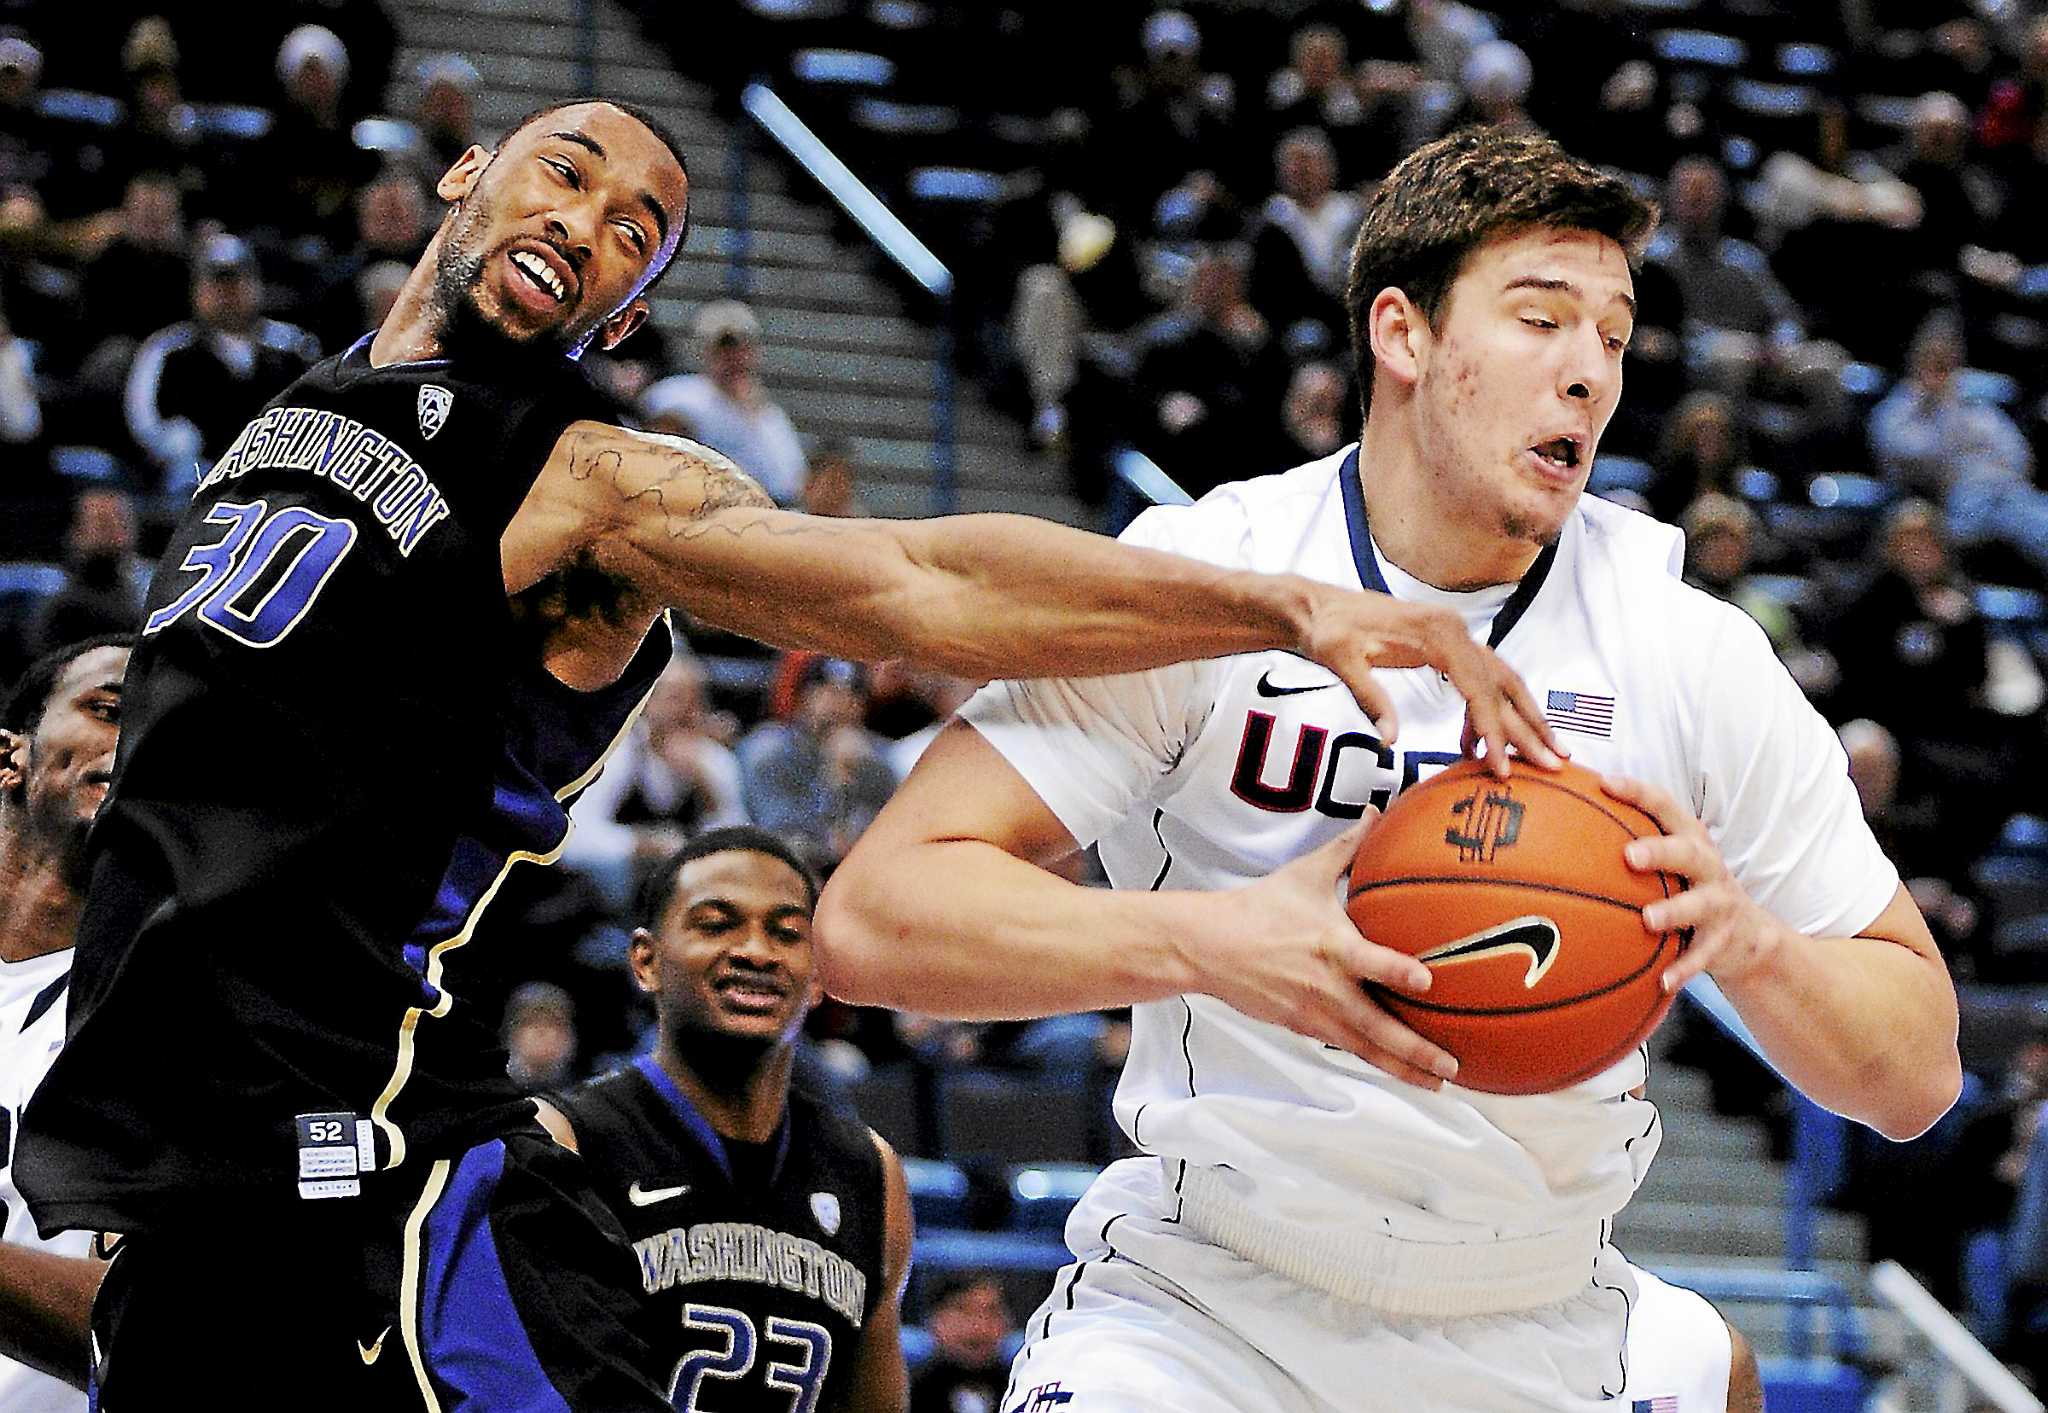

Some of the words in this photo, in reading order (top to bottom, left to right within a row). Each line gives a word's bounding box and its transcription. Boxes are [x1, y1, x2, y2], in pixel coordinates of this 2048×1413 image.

[142, 499, 358, 648] 30
[309, 1121, 343, 1142] 52
[668, 1302, 832, 1413] 23
